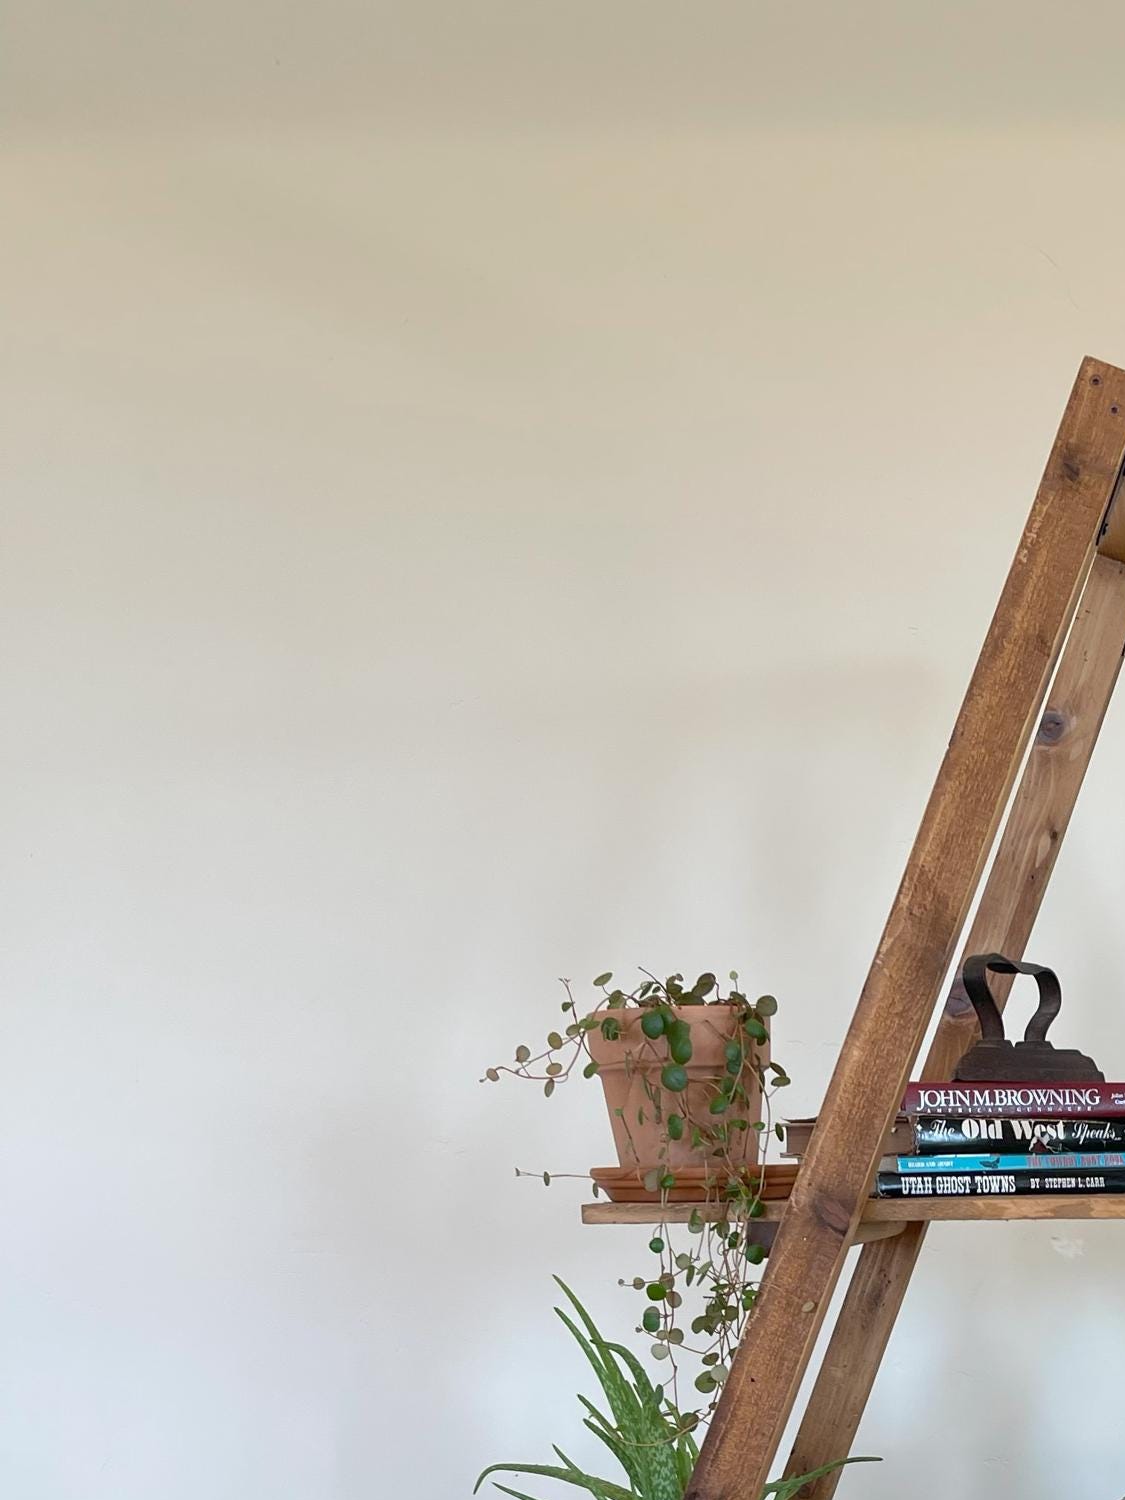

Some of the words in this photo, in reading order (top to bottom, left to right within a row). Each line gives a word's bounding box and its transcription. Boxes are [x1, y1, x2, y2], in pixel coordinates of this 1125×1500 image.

[917, 1089, 970, 1111] JOHN
[994, 1088, 1101, 1106] BROWNING
[929, 1119, 955, 1137] The
[961, 1118, 1004, 1140] Old
[1010, 1118, 1066, 1140] West
[900, 1176, 933, 1195] UTAH
[935, 1175, 972, 1195] GHOST
[974, 1175, 1017, 1194] TOWNS
[1030, 1178, 1040, 1189] BY
[1044, 1177, 1076, 1189] STEPHEN
[1085, 1176, 1106, 1188] CARR
